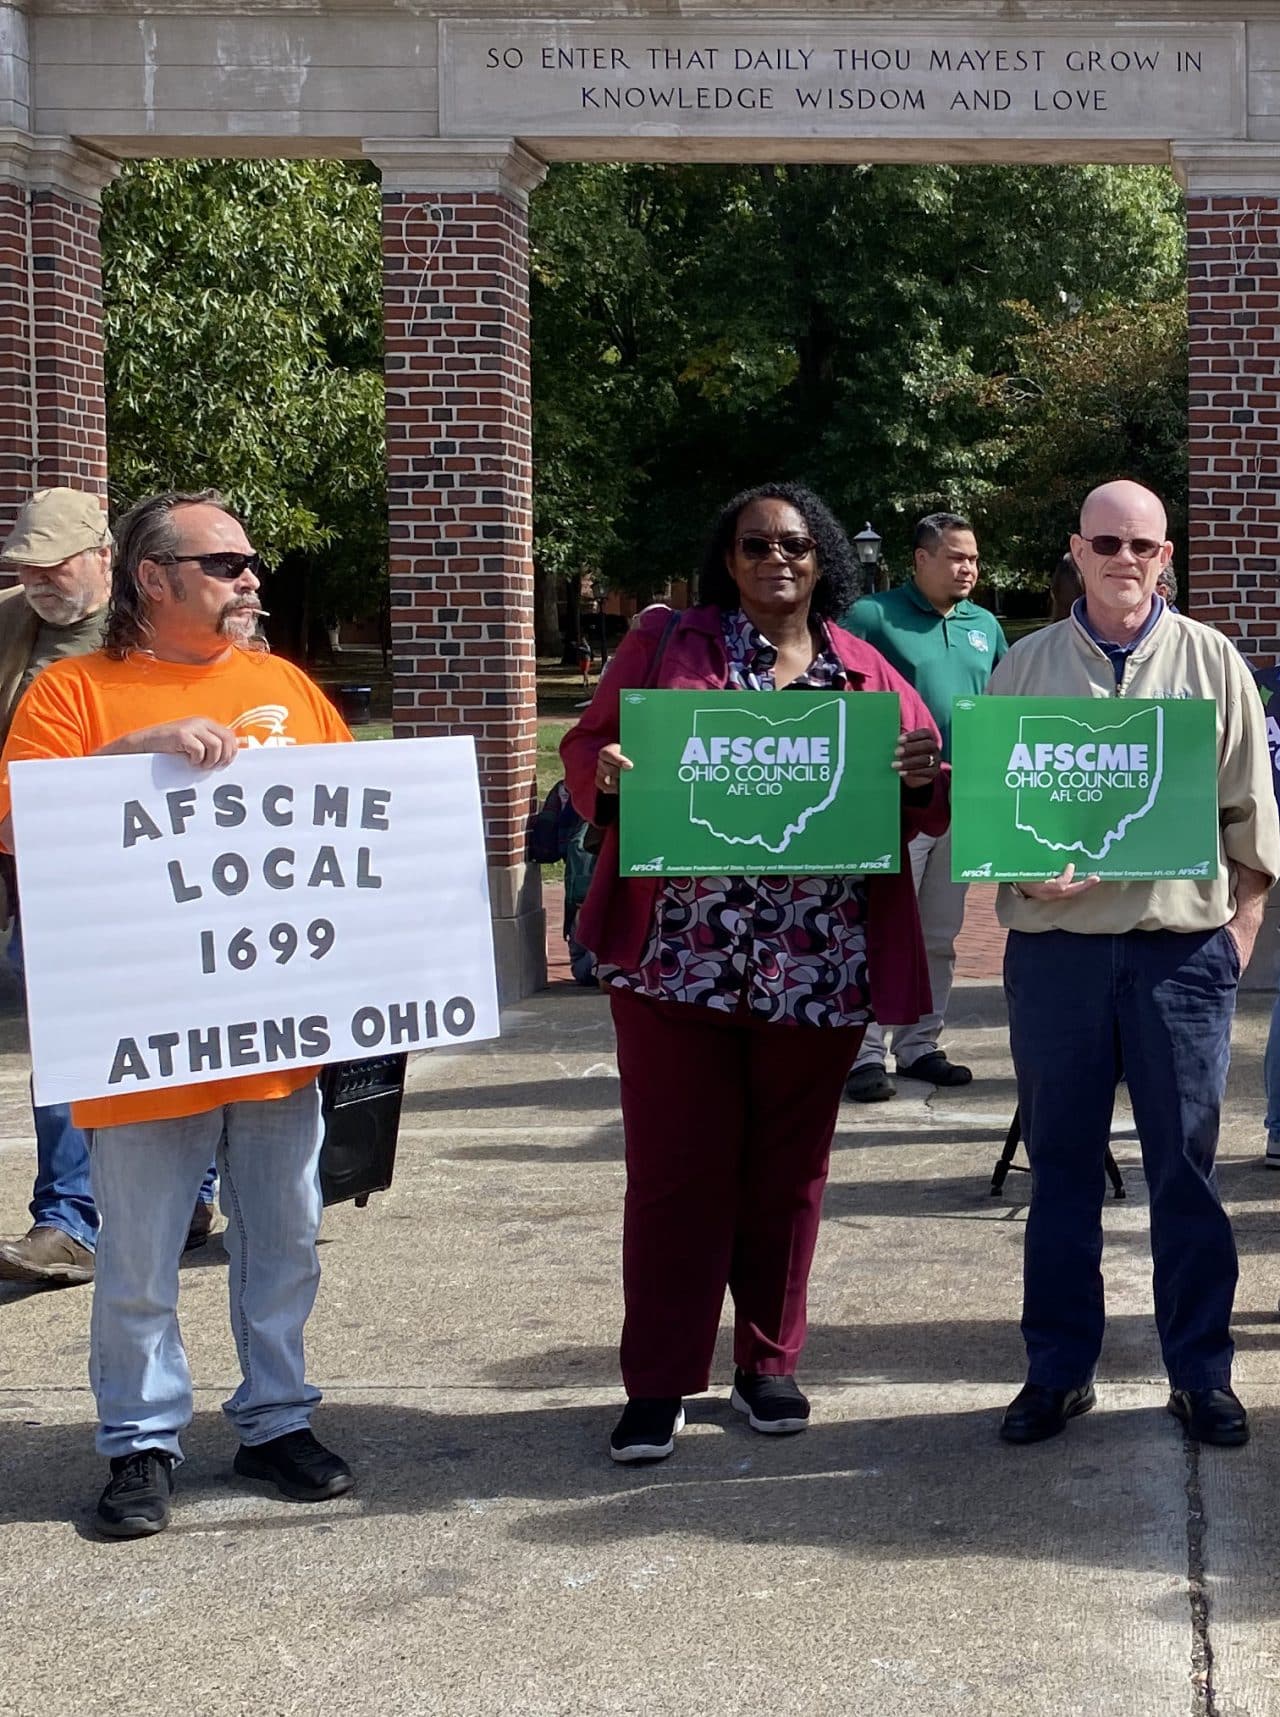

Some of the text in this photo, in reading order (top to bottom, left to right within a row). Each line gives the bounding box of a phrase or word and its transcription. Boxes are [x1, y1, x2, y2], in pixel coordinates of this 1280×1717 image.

[486, 47, 1202, 72] SO ENTER THAT DAILY THOU MAYEST GROW IN
[580, 87, 1108, 110] KNOWLEDGE WISDOM AND LOVE
[680, 737, 830, 764] AFSCME
[1007, 743, 1148, 771] AFSCME
[678, 765, 830, 782] OHIO COUNCIL 8
[1005, 771, 1149, 788] OHIO COUNCIL 8
[122, 783, 392, 848] AFSCME
[167, 845, 382, 903] LOCAL
[200, 917, 336, 974] 1699
[108, 1015, 331, 1084] ATHENS
